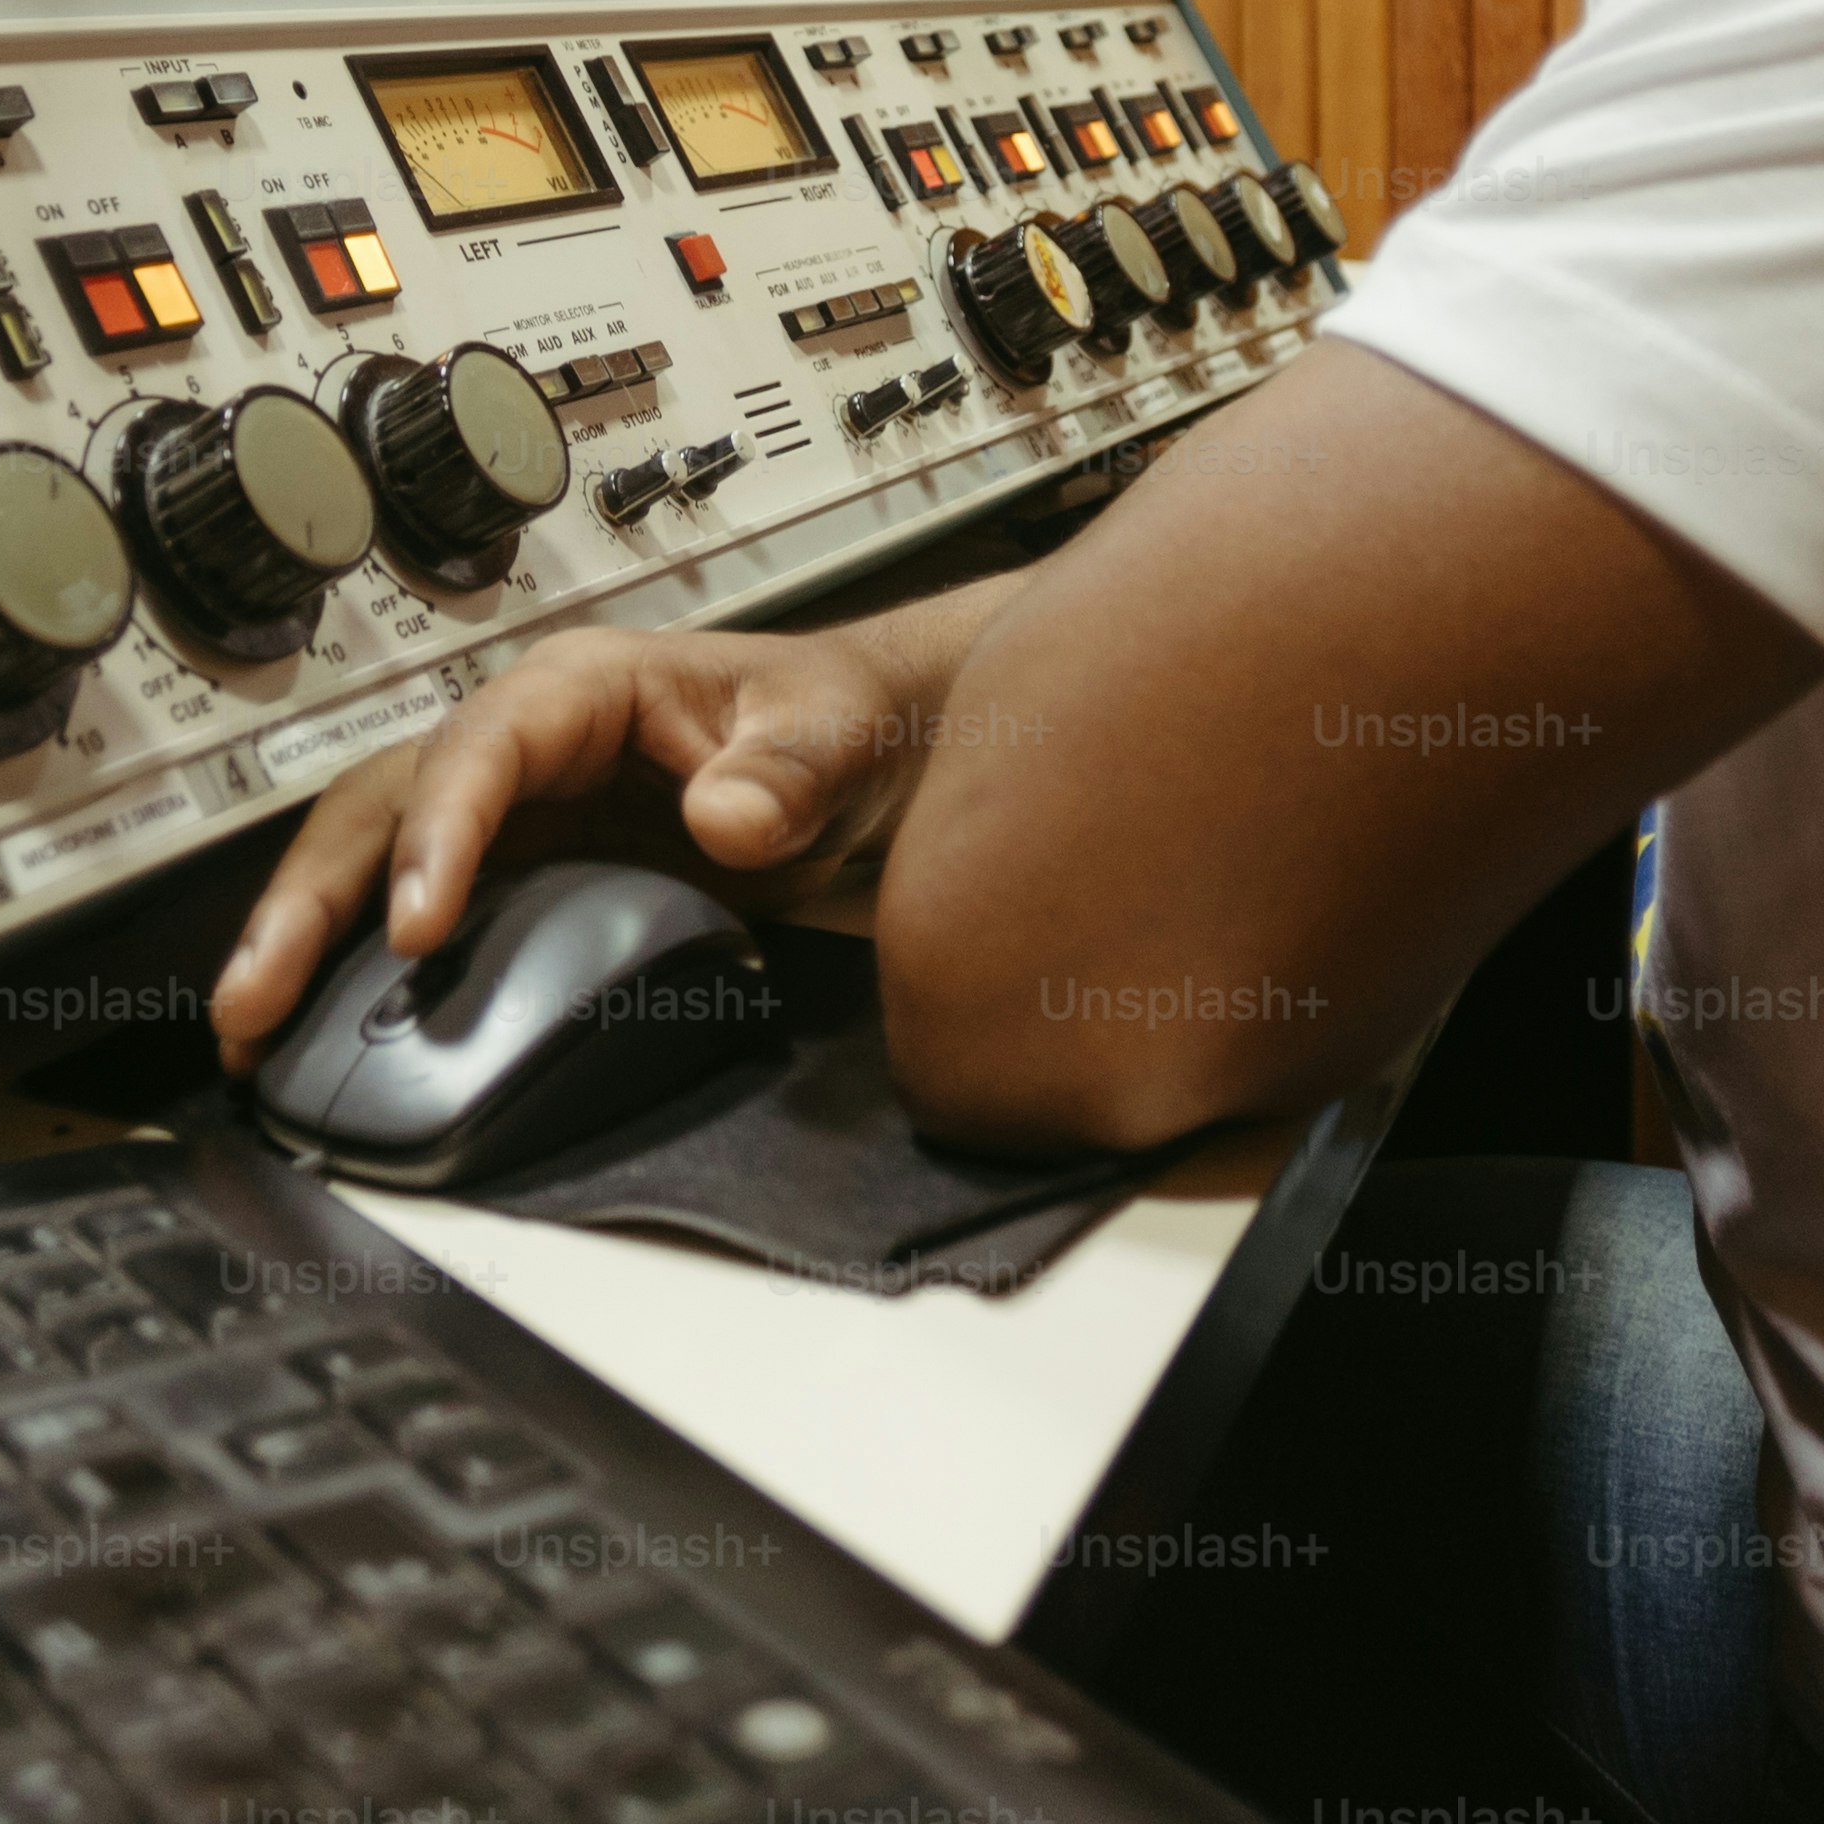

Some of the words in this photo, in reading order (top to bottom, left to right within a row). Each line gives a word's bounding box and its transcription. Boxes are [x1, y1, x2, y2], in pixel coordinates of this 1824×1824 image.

[804, 24, 828, 36] INPUT
[561, 39, 575, 52] VU
[577, 37, 604, 51] METER
[143, 59, 193, 76] INPUT
[297, 116, 312, 128] TB
[313, 114, 333, 128] MIC
[572, 64, 601, 110] PGM
[602, 119, 628, 165] AUD
[173, 132, 189, 150] A
[219, 128, 235, 146] B
[775, 146, 793, 160] VU
[261, 177, 286, 194] ON
[302, 172, 331, 190] OFF
[546, 176, 569, 192] VU
[800, 182, 838, 203] RIGHT
[35, 203, 66, 222] ON
[86, 196, 122, 216] OFF
[460, 238, 503, 263] LEFT
[782, 253, 824, 272] HEADPHONES
[767, 281, 791, 299] PGM
[795, 276, 815, 293] AUD
[819, 271, 839, 287] AUX
[865, 260, 886, 275] CUE
[694, 292, 734, 311] TALKBACK
[513, 312, 553, 331] MONITOR
[553, 303, 597, 323] SELECTOR
[336, 322, 350, 342] 5
[391, 332, 406, 352] 6
[501, 342, 529, 360] GM
[536, 334, 564, 354] AUD
[571, 326, 597, 345] AUX
[606, 319, 629, 337] AIR
[296, 352, 309, 371] 4
[853, 341, 889, 360] PHONES
[118, 364, 135, 386] 5
[812, 357, 832, 374] CUE
[185, 374, 202, 395] 6
[67, 399, 82, 419] 4
[620, 406, 663, 429] STUDIO
[571, 422, 608, 444] ROOM
[515, 572, 538, 594] 10
[370, 594, 399, 617] OFF
[394, 613, 431, 640] CUE
[321, 642, 347, 667] 10
[139, 674, 177, 702] OFF
[439, 666, 463, 702] 5
[168, 691, 215, 725] CUE
[357, 707, 395, 735] MESA
[392, 699, 409, 719] DE
[408, 691, 438, 713] SOM
[75, 728, 106, 758] 10
[224, 756, 250, 796] 4
